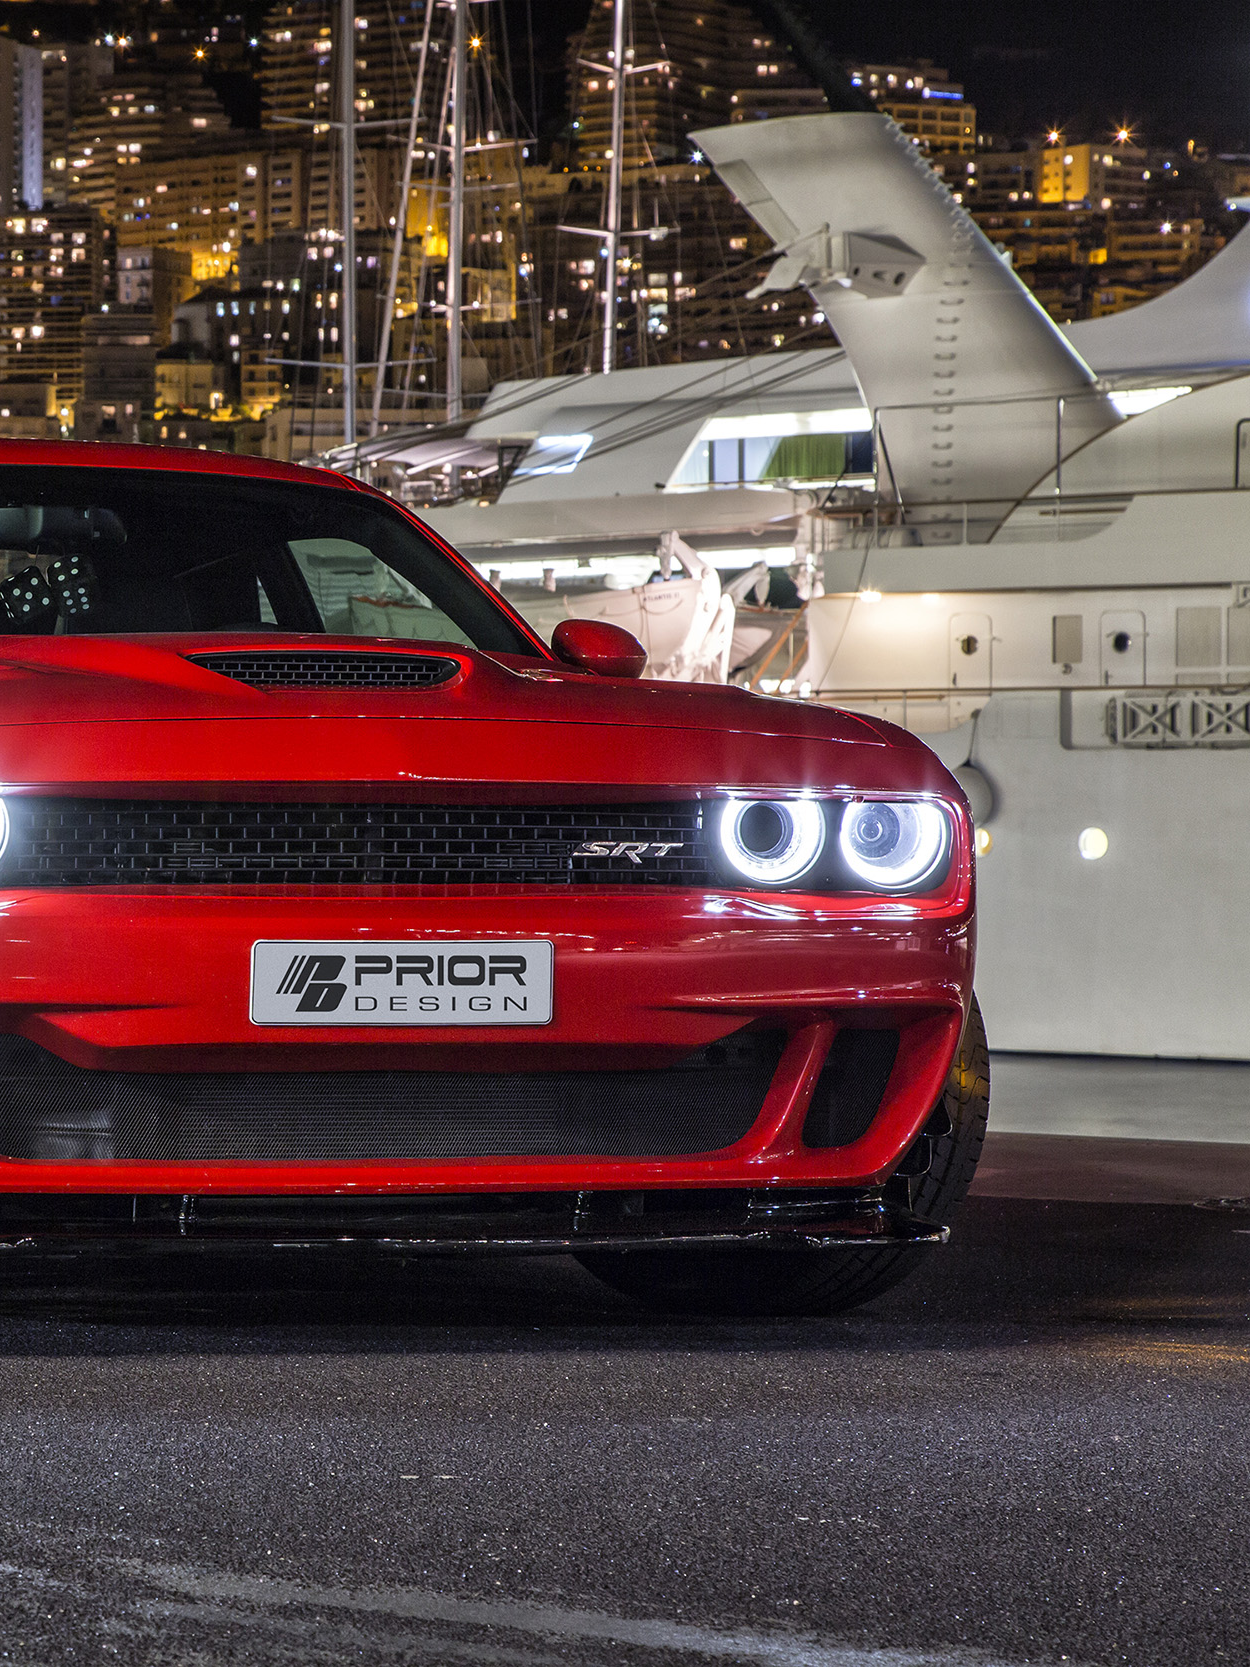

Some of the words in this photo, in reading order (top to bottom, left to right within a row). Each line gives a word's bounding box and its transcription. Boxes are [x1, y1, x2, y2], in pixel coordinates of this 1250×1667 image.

[572, 841, 685, 864] SRT
[354, 955, 527, 986] PRIOR
[354, 996, 528, 1012] DESIGN
